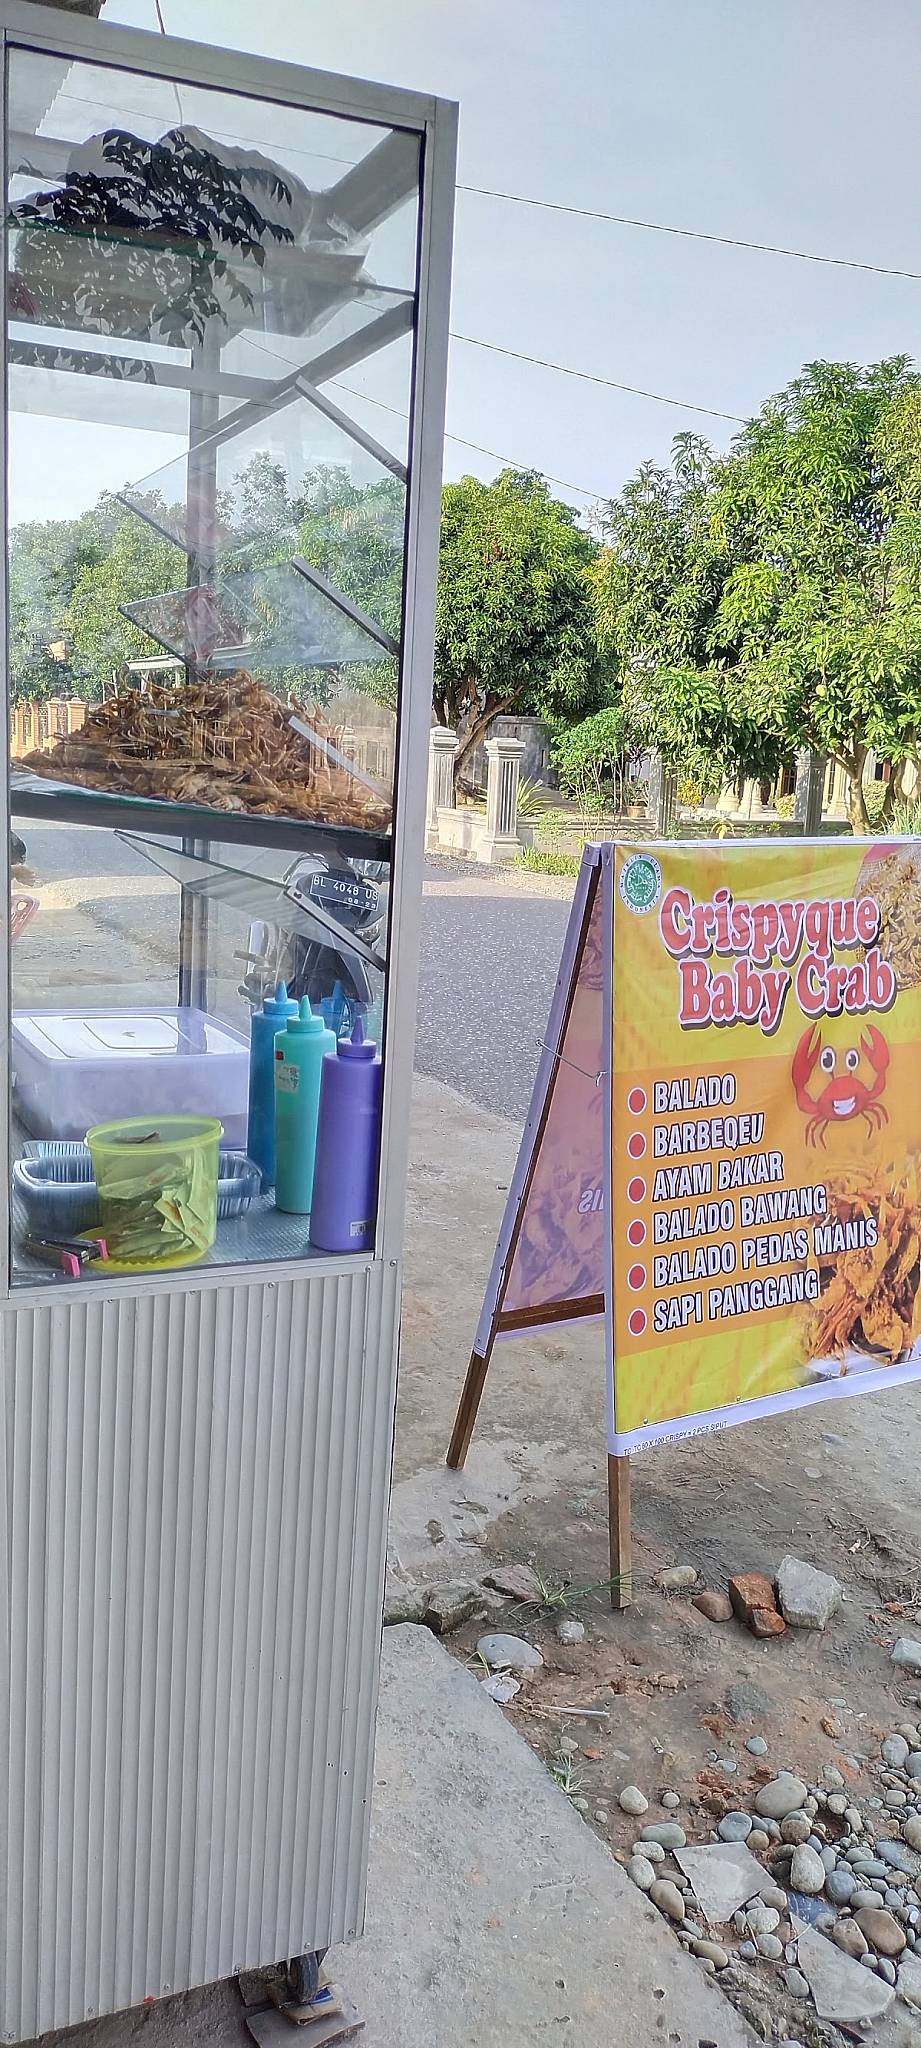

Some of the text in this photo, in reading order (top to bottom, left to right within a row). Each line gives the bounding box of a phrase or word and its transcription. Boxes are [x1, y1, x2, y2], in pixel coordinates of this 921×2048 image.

[313, 876, 379, 901] BL 4048 US
[659, 887, 881, 963] Crispyque
[679, 948, 898, 1034] Baby Crab
[654, 1073, 736, 1113] BALADO
[653, 1113, 765, 1158] BARBEQEU
[652, 1151, 784, 1202] AYAM BAKAR
[653, 1185, 827, 1244] BALADO BAWANG
[653, 1216, 879, 1288] BALADO PEDAS MANIS
[653, 1269, 819, 1332] SAPI PANGGANG
